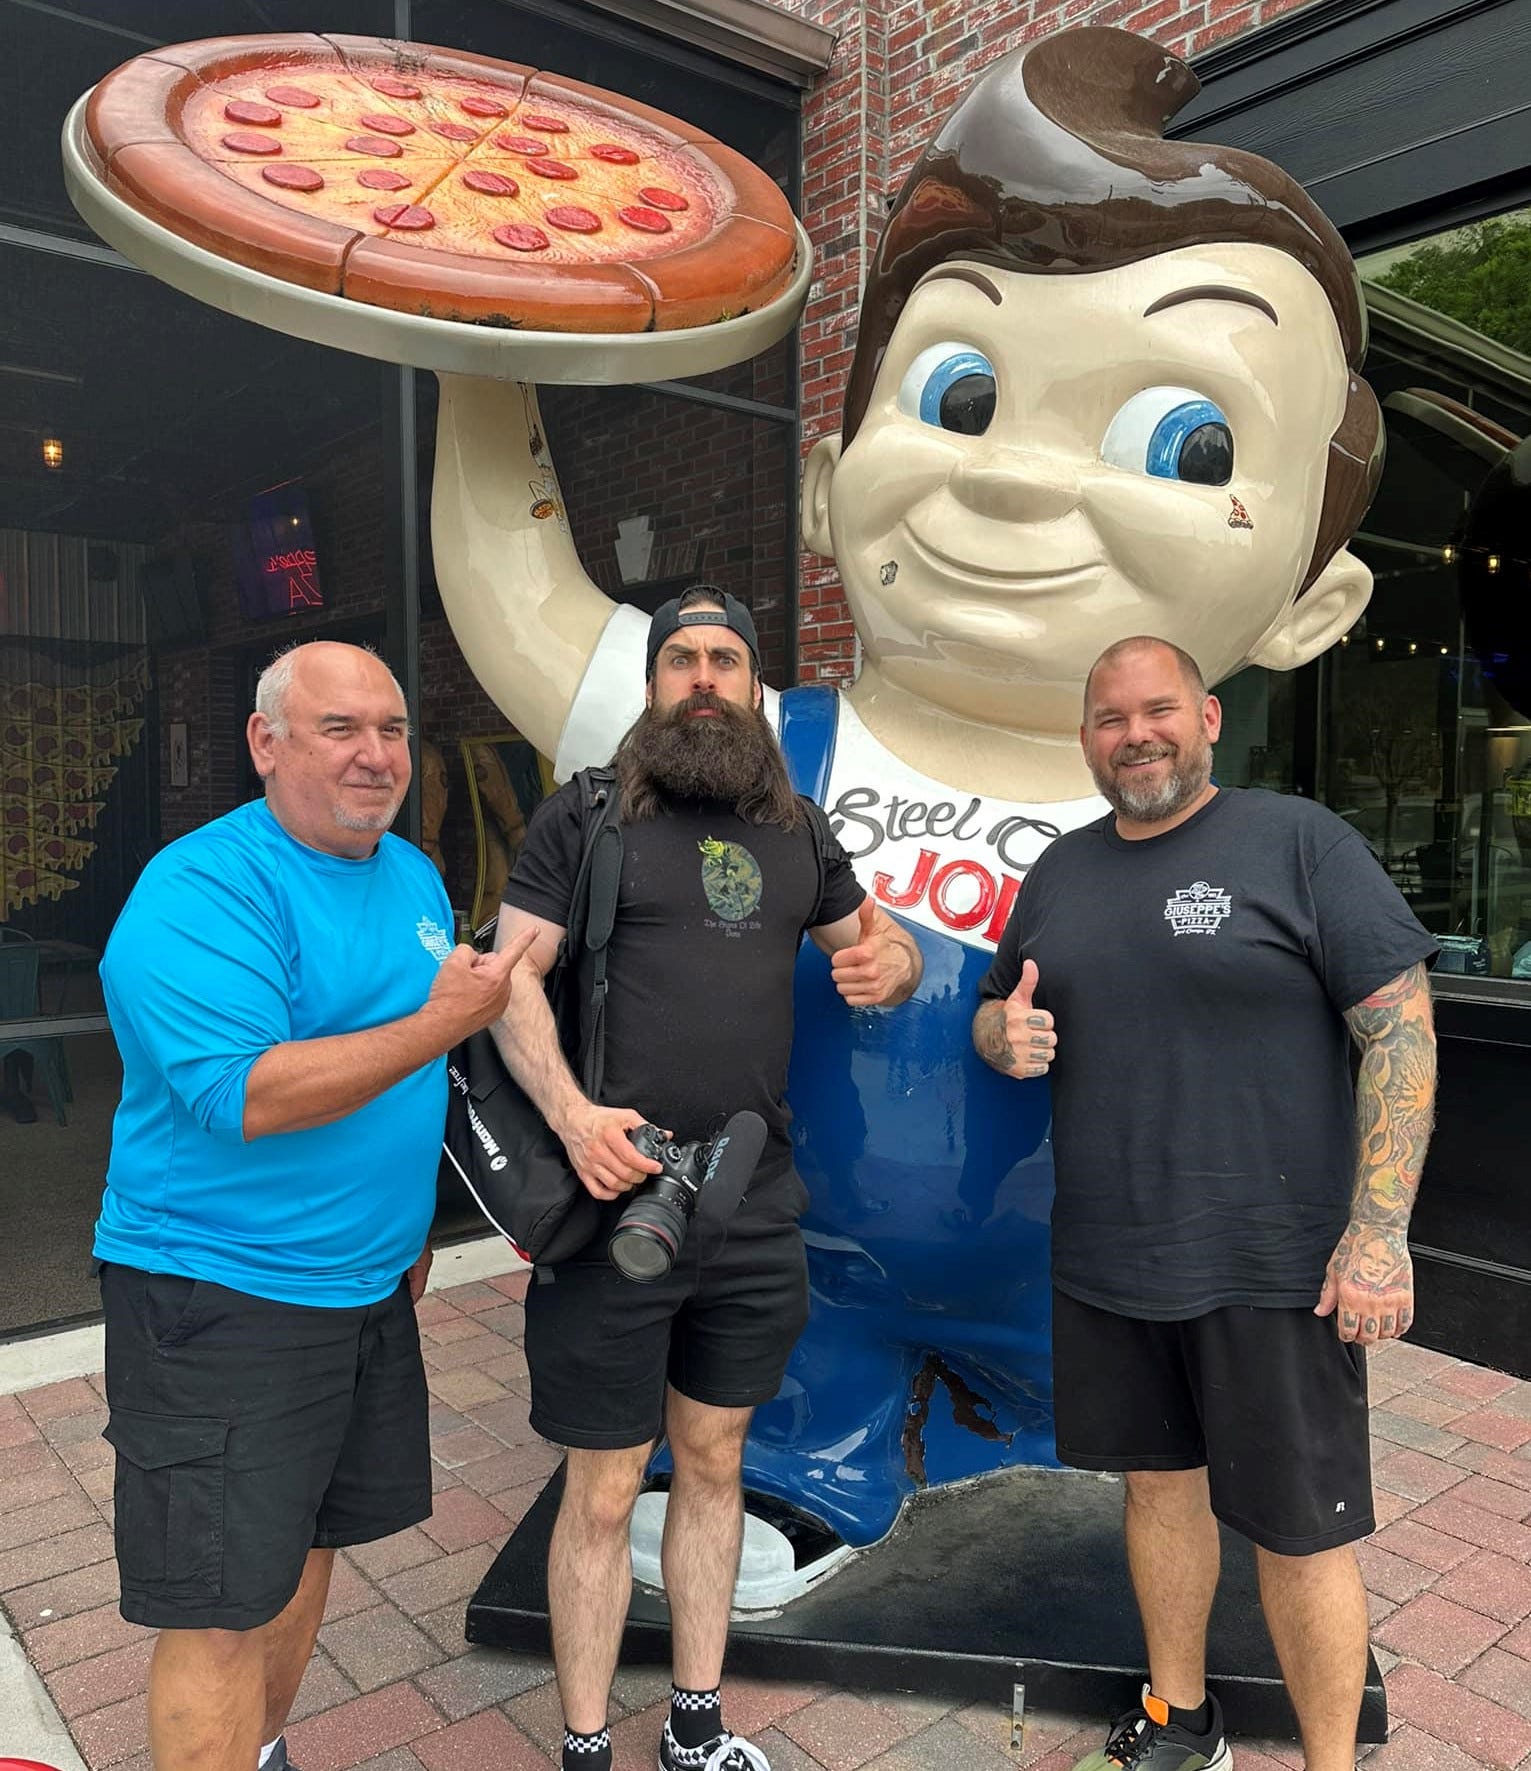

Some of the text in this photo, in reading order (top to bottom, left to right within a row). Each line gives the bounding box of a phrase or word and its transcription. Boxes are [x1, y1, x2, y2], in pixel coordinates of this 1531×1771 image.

[827, 787, 982, 860] Steel
[1164, 904, 1232, 917] GIUSEPPE'S
[1181, 917, 1210, 926] PIZZA
